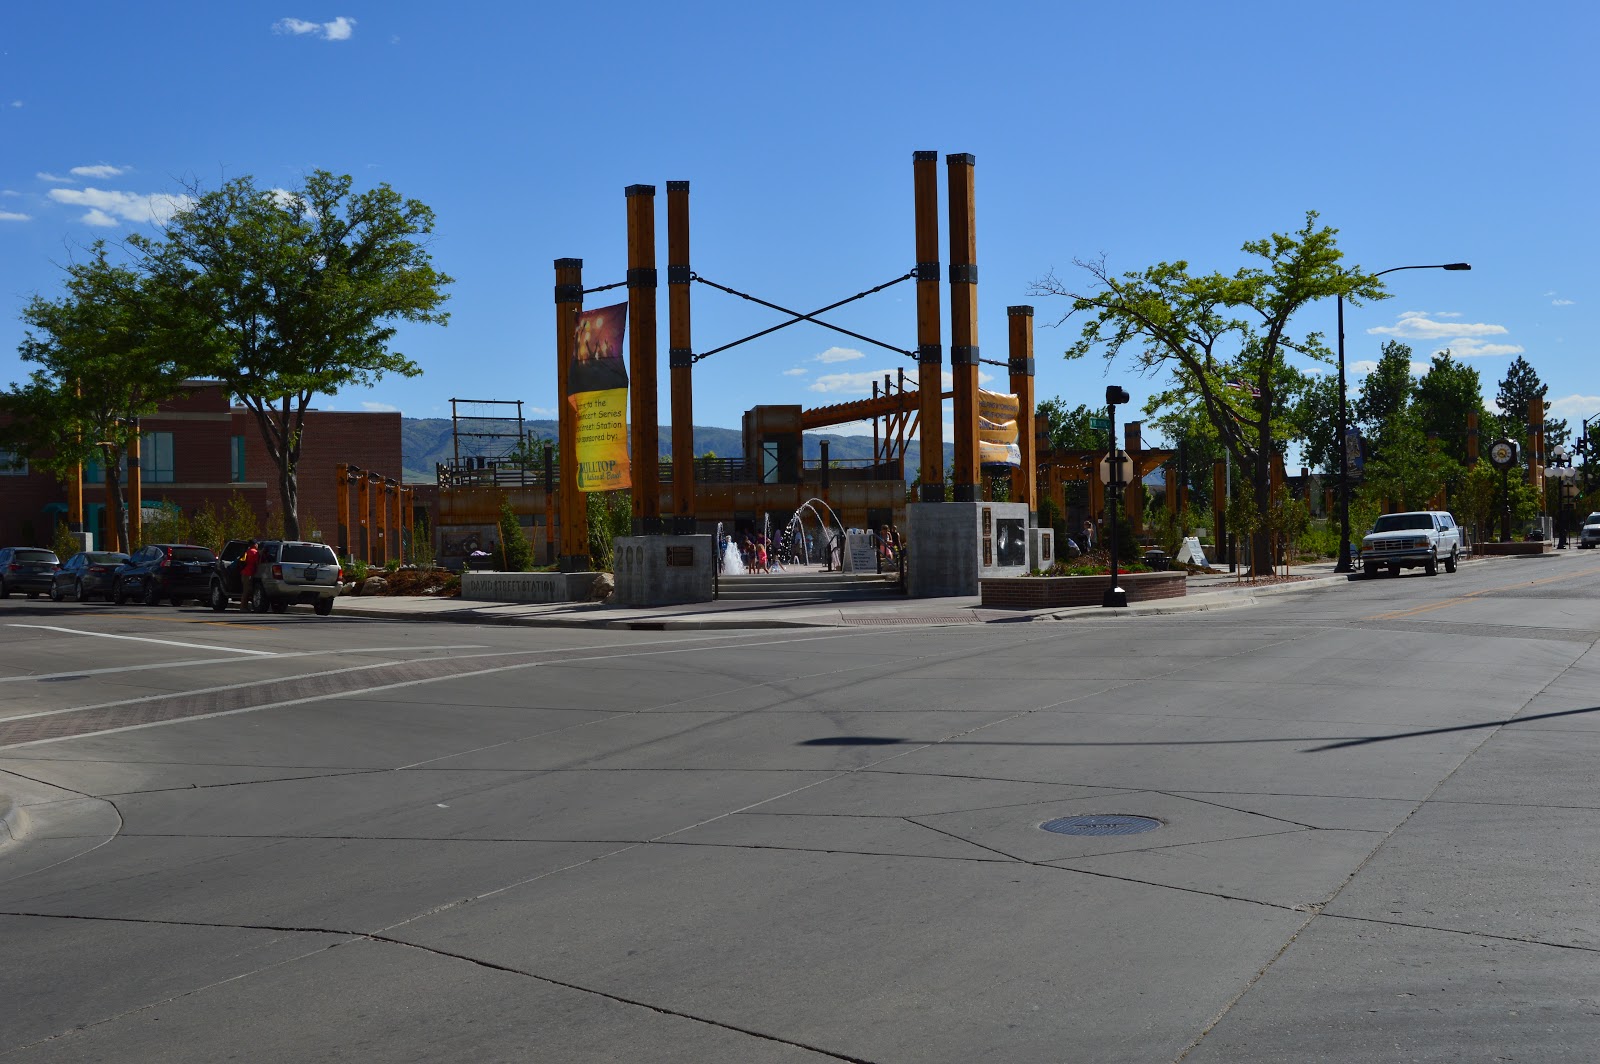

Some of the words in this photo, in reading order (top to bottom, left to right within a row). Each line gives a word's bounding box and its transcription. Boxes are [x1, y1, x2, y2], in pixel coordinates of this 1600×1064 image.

[594, 398, 607, 407] the
[598, 410, 622, 419] Series
[596, 421, 622, 430] Station
[606, 431, 618, 442] by:
[579, 460, 616, 473] HILLTOP
[470, 580, 493, 592] DAVID
[494, 580, 521, 592] STREET
[522, 580, 556, 593] STATION
